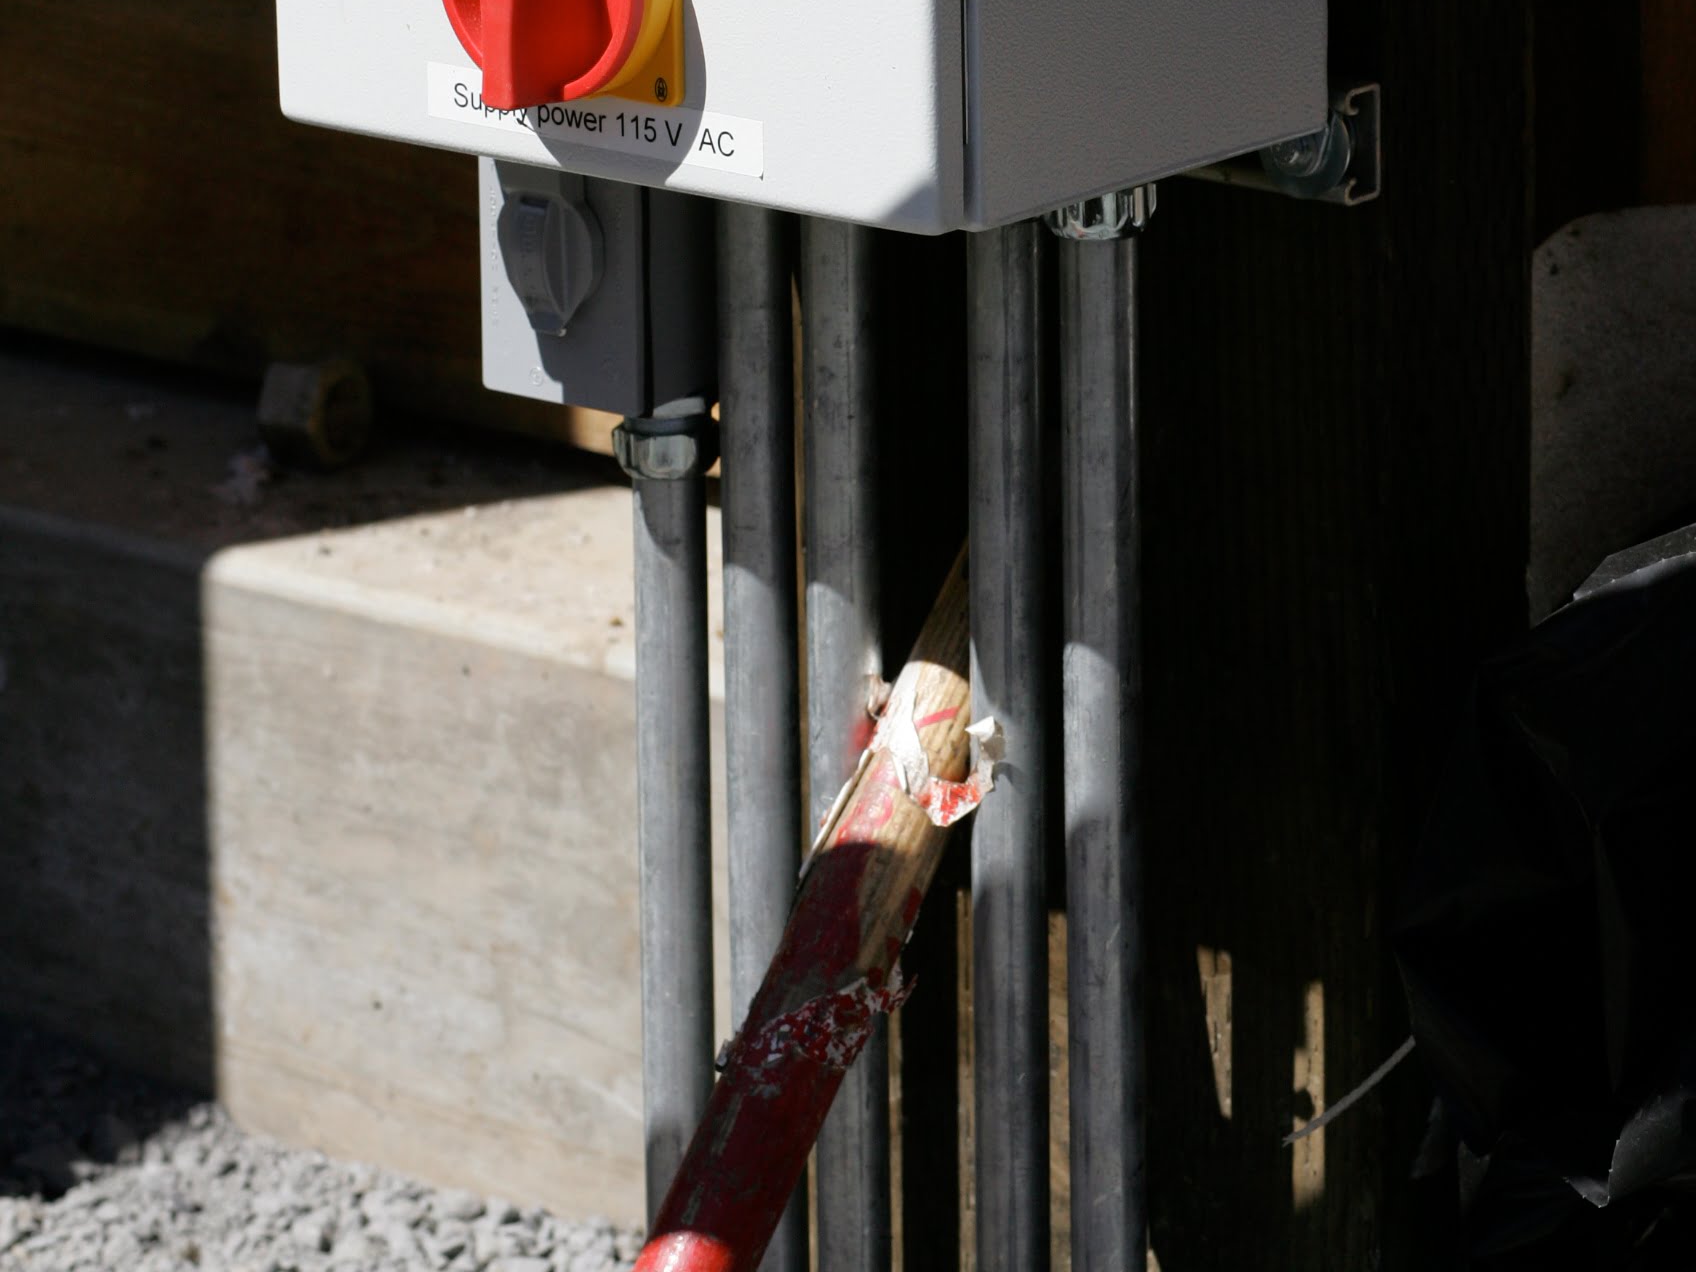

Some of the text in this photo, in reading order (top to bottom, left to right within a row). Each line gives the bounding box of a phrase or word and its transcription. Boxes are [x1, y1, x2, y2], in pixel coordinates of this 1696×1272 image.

[453, 82, 736, 158] Suppy power 115 V AC
